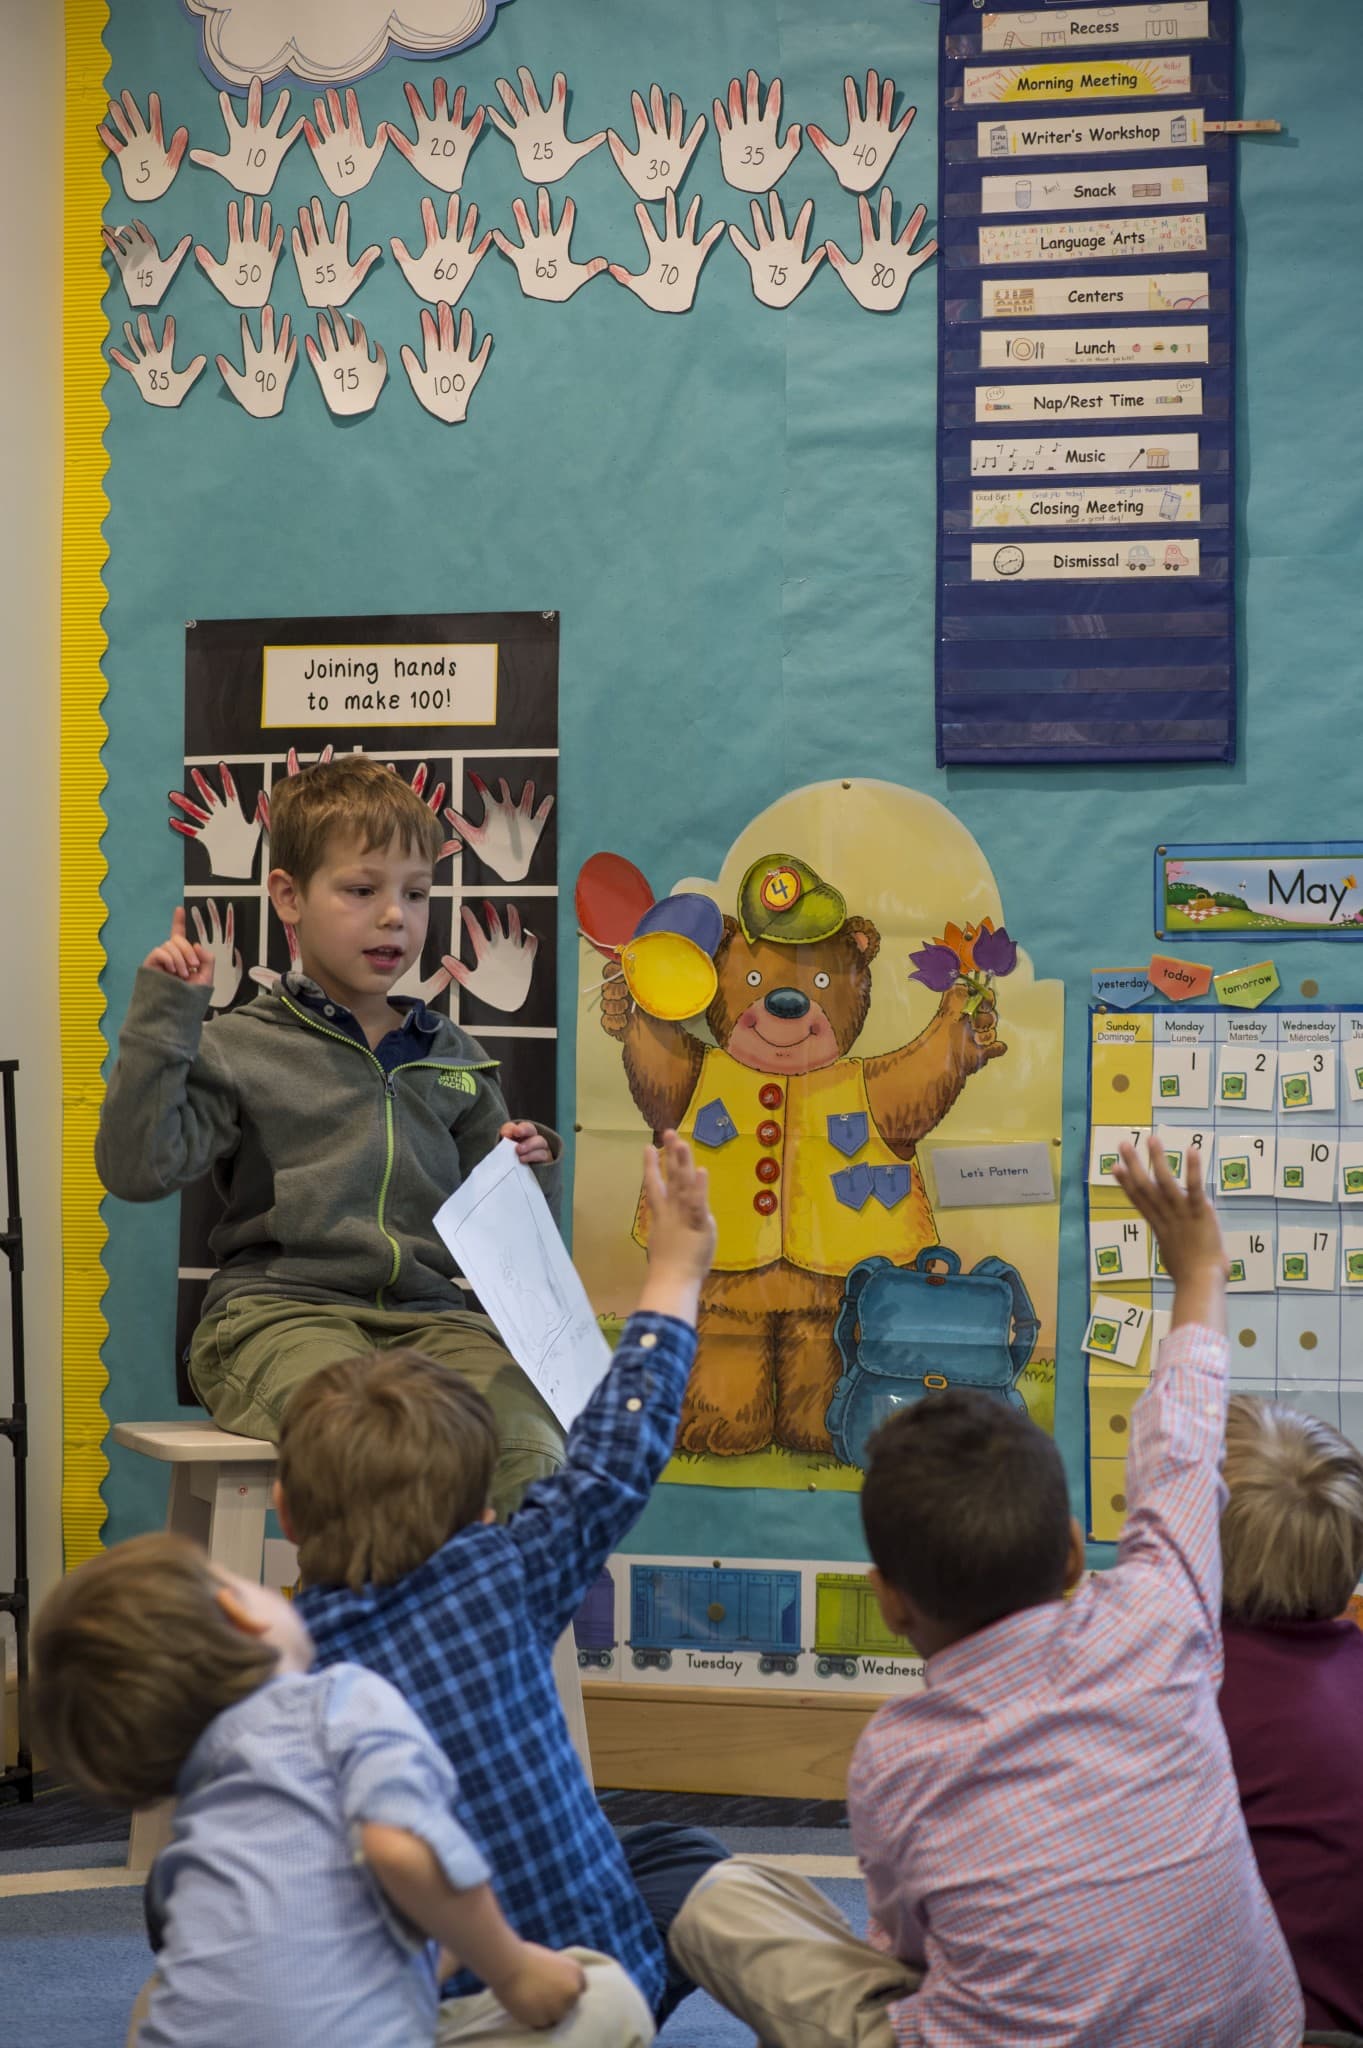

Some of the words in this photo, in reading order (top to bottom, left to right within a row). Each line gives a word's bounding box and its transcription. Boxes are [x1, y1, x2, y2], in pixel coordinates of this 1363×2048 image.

[1070, 21, 1119, 35] Recess
[1017, 75, 1073, 92] Morning
[1080, 72, 1138, 89] Meeting
[1022, 128, 1082, 146] Writer's
[1090, 125, 1160, 142] Workshop
[246, 147, 266, 168] 10
[430, 138, 456, 158] 20
[532, 141, 554, 160] 25
[740, 146, 765, 165] 35
[853, 145, 877, 167] 40
[135, 160, 152, 184] 5
[336, 155, 356, 177] 15
[646, 159, 671, 180] 30
[1073, 183, 1116, 198] Snack
[1040, 233, 1106, 251] Language
[1113, 231, 1145, 245] Arts
[235, 264, 262, 286] 50
[315, 264, 337, 284] 55
[433, 259, 459, 281] 60
[535, 258, 558, 279] 65
[660, 264, 679, 285] 70
[768, 265, 788, 286] 75
[871, 263, 896, 288] 80
[136, 269, 154, 288] 45
[1067, 289, 1124, 304] Centers
[1074, 340, 1116, 355] Lunch
[148, 369, 170, 390] 85
[255, 371, 276, 392] 90
[334, 367, 360, 390] 95
[433, 374, 465, 394] 100
[1033, 394, 1103, 413] Nap/Rest
[1110, 394, 1145, 407] Time
[1065, 449, 1106, 463] Music
[1030, 501, 1079, 518] Closing
[1086, 499, 1144, 516] Meeting
[1054, 554, 1119, 569] Dismissal
[304, 658, 379, 684] Joining
[394, 657, 457, 678] hands
[308, 693, 329, 710] to
[345, 690, 400, 710] make
[410, 688, 452, 709] 100!
[771, 878, 789, 901] 4
[1268, 868, 1349, 921] May
[1097, 978, 1149, 994] yesterday
[1163, 968, 1197, 988] today
[1222, 974, 1272, 996] tomorrow
[1106, 1021, 1141, 1035] Sunday
[1165, 1021, 1205, 1036] Monday
[1227, 1020, 1268, 1035] Tuesday
[1229, 1032, 1259, 1041] Martes
[1282, 1020, 1337, 1035] Wednesday
[1097, 1032, 1135, 1043] Domingo
[1171, 1034, 1198, 1043] Lunes
[1191, 1052, 1196, 1070] 1
[1255, 1054, 1267, 1072] 2
[1313, 1055, 1324, 1072] 3
[1131, 1132, 1141, 1148] 7
[1254, 1139, 1265, 1157] 9
[1311, 1144, 1329, 1162] 10
[960, 1168, 984, 1179] Let's
[989, 1166, 1029, 1177] Pattern
[1123, 1224, 1139, 1242] 14
[1314, 1233, 1328, 1251] 17
[1250, 1235, 1265, 1253] 16
[1124, 1308, 1144, 1328] 21
[686, 1654, 743, 1677] Tuesday
[862, 1659, 926, 1677] Wednesd
